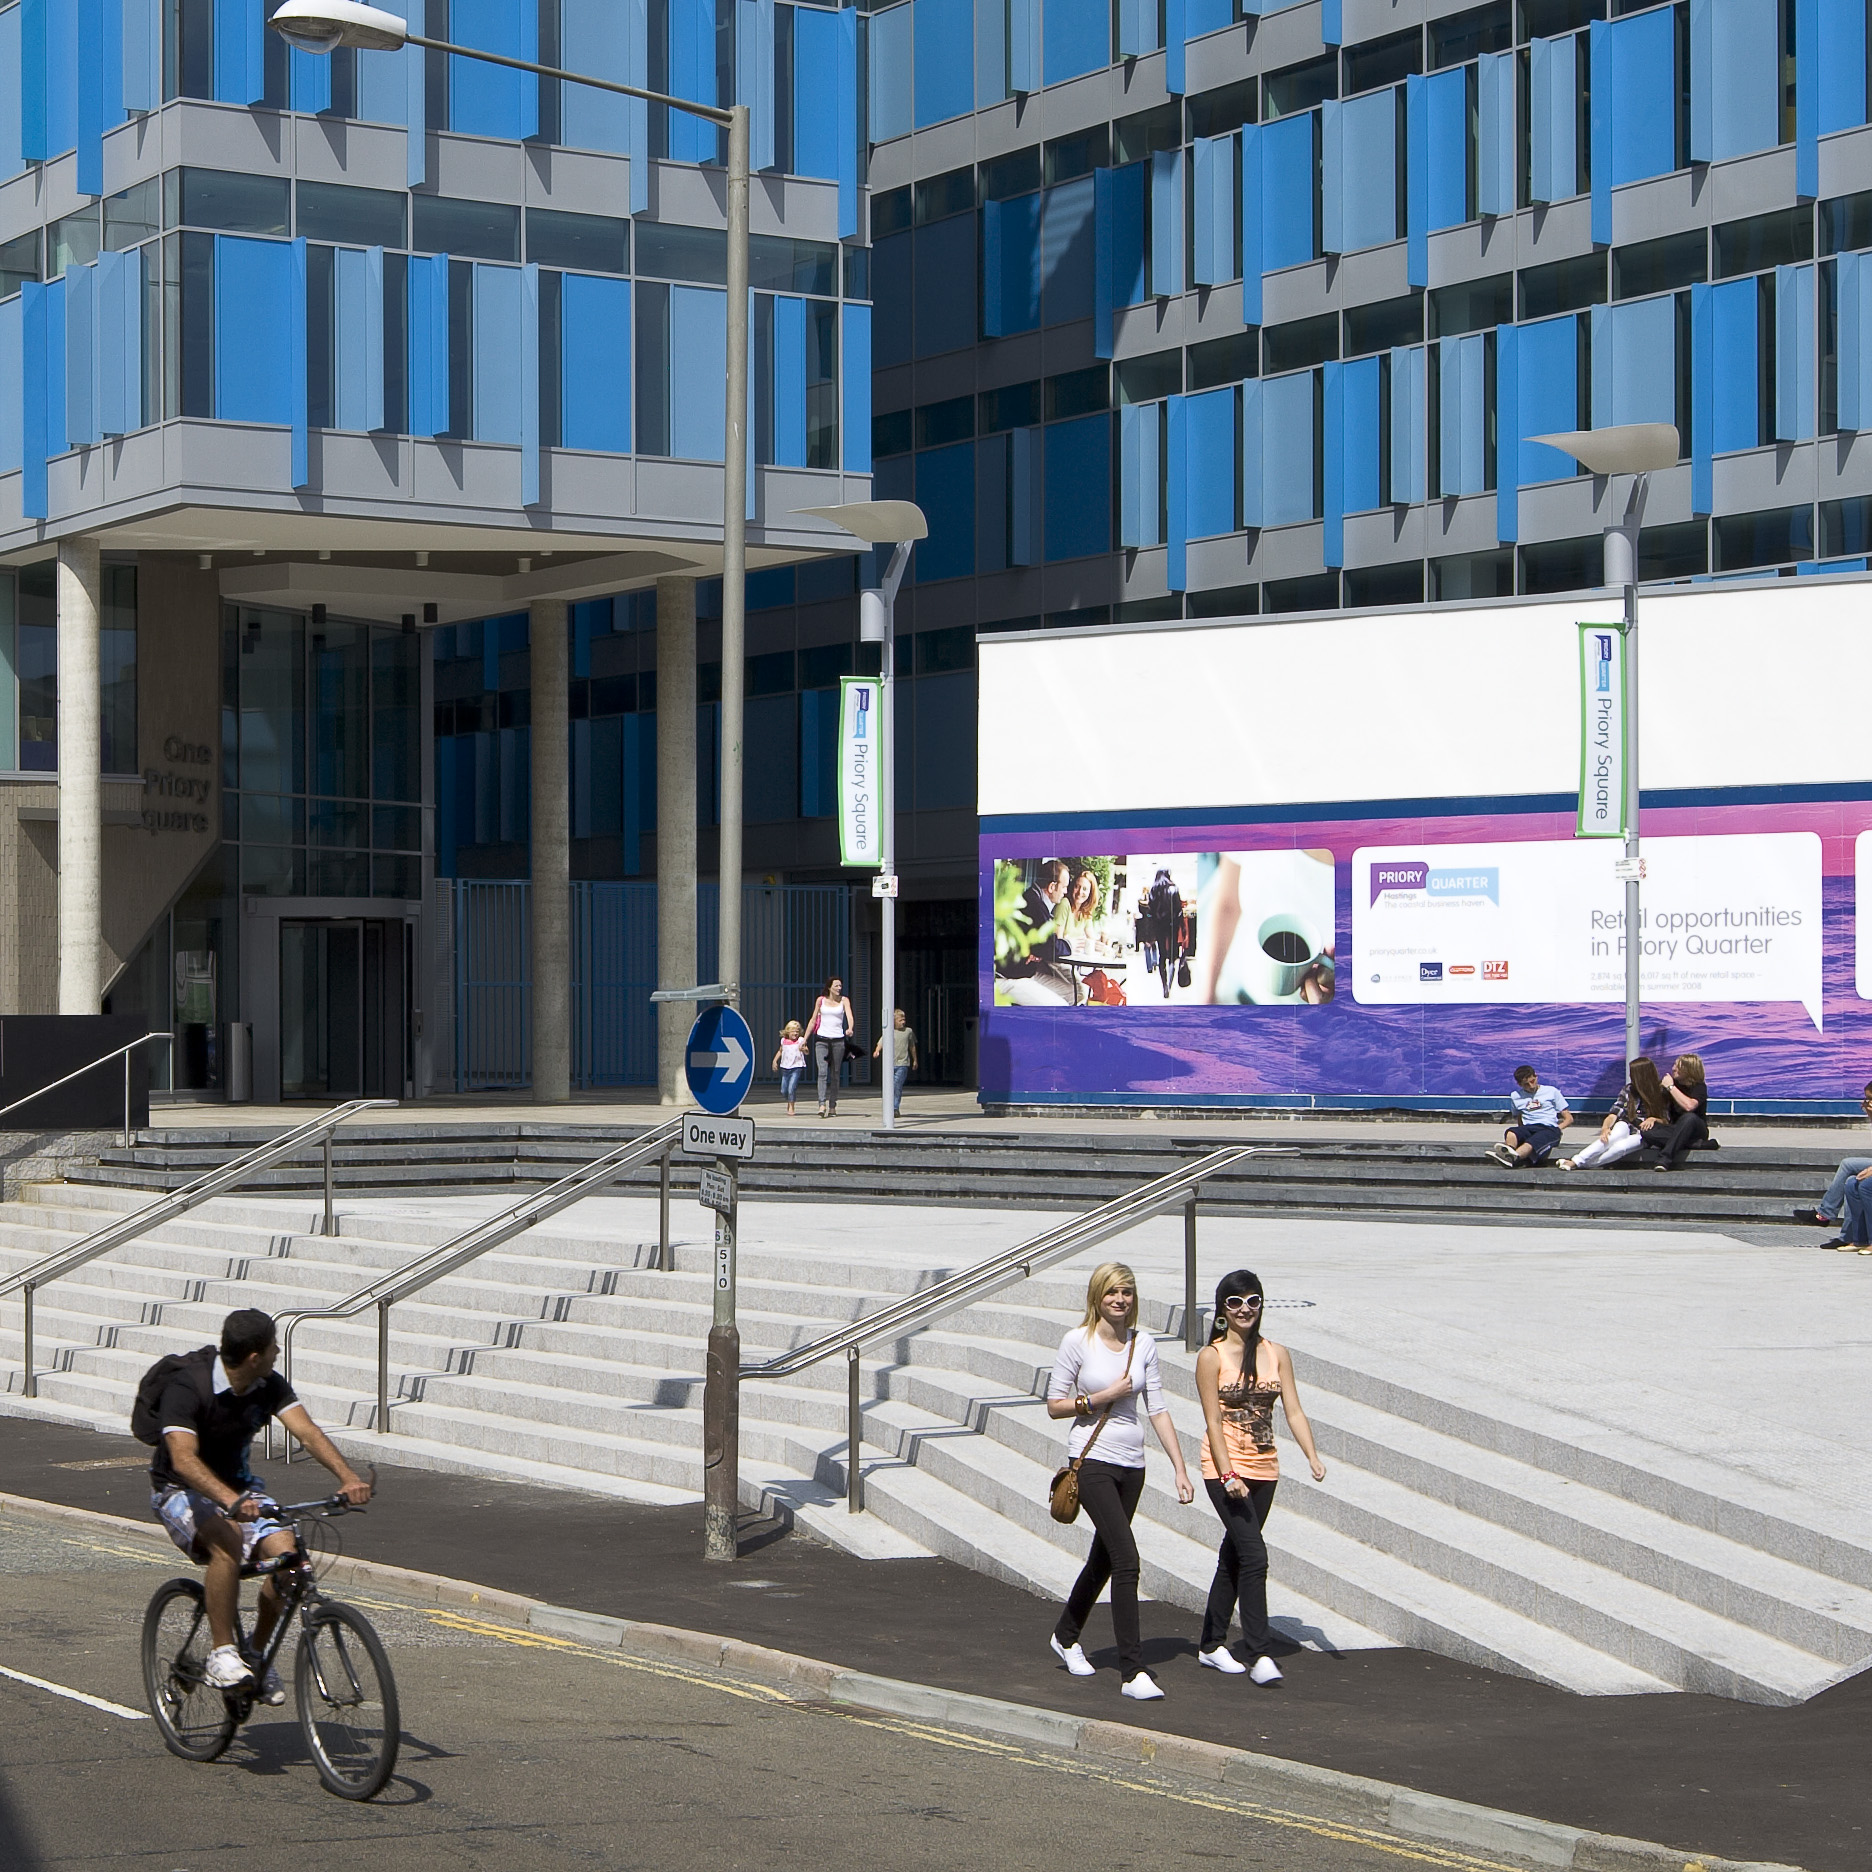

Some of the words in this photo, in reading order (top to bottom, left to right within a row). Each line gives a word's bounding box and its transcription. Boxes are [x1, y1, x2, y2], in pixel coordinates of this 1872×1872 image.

[1594, 698, 1612, 749] Priory
[164, 736, 212, 765] One
[853, 744, 869, 789] Priory
[144, 768, 211, 804] Priory
[1593, 754, 1612, 820] Square
[128, 810, 209, 836] quare
[852, 793, 869, 850] Square
[1378, 870, 1423, 884] PRIORY
[1431, 877, 1488, 890] QUARTER
[1384, 892, 1417, 901] Hastings
[1399, 900, 1426, 908] coastal
[1427, 900, 1460, 908] business
[1462, 899, 1485, 907] haven
[1591, 908, 1647, 929] Retil
[1655, 906, 1803, 933] opportunities
[1591, 937, 1609, 956] in
[1618, 936, 1678, 960] Piory
[1686, 935, 1773, 955] Quarter
[1483, 961, 1505, 973] DTZ
[1709, 970, 1730, 979] retail
[1731, 972, 1756, 980] space
[1682, 982, 1702, 990] 2008
[689, 1124, 716, 1144] One
[718, 1131, 747, 1150] way
